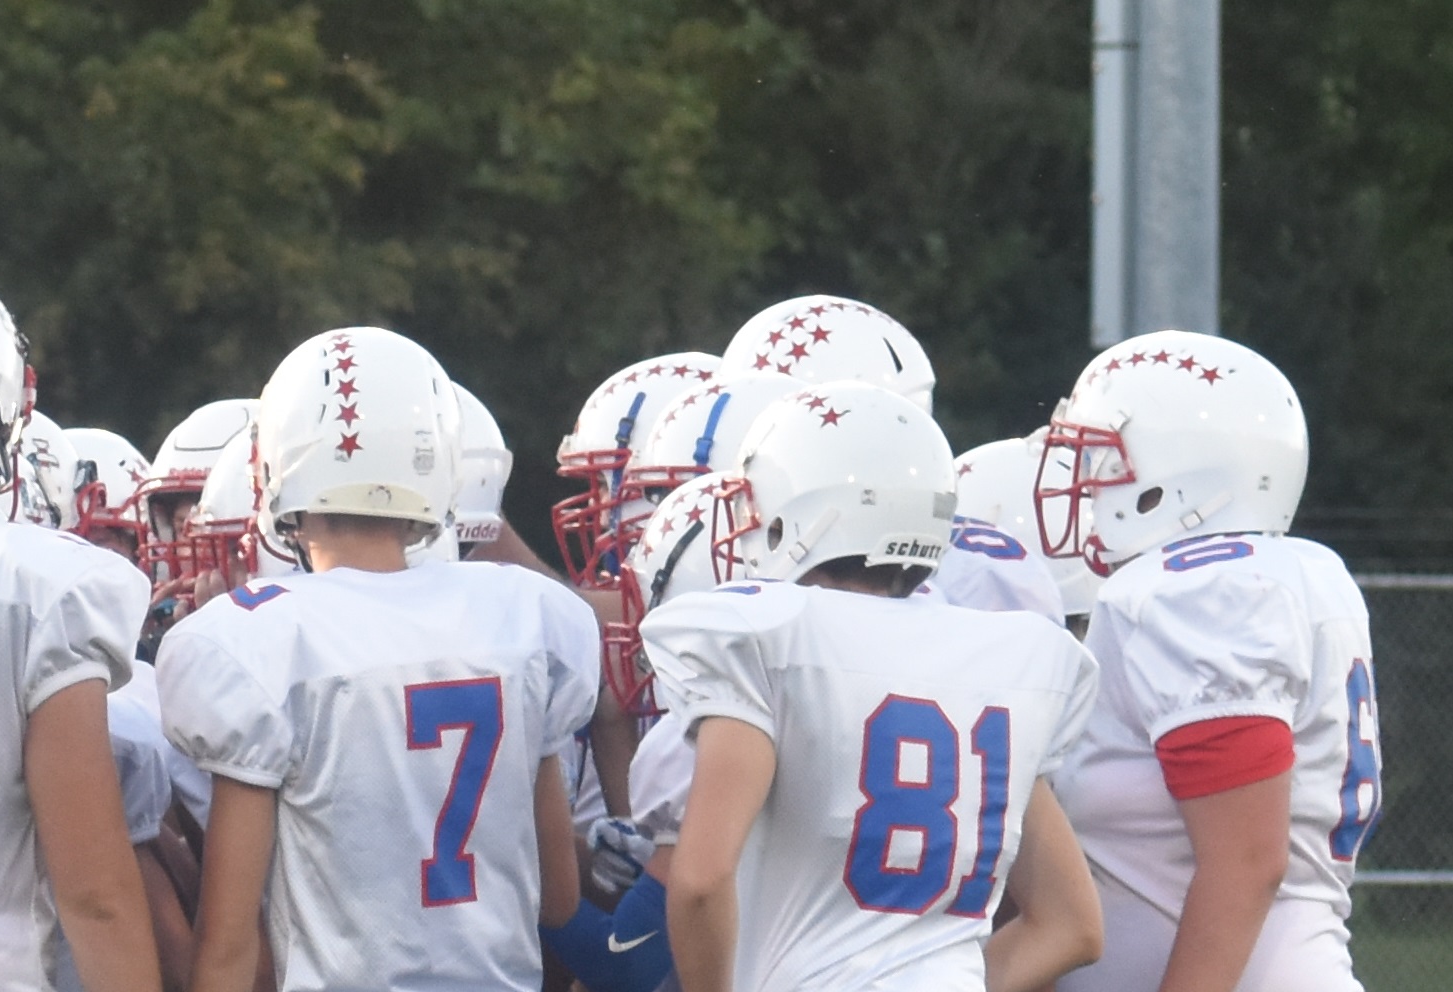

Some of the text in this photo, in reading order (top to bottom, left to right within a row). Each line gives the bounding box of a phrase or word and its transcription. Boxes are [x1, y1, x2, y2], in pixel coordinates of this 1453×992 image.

[885, 539, 942, 559] schutt
[404, 677, 504, 909] 7
[842, 692, 1011, 919] 81
